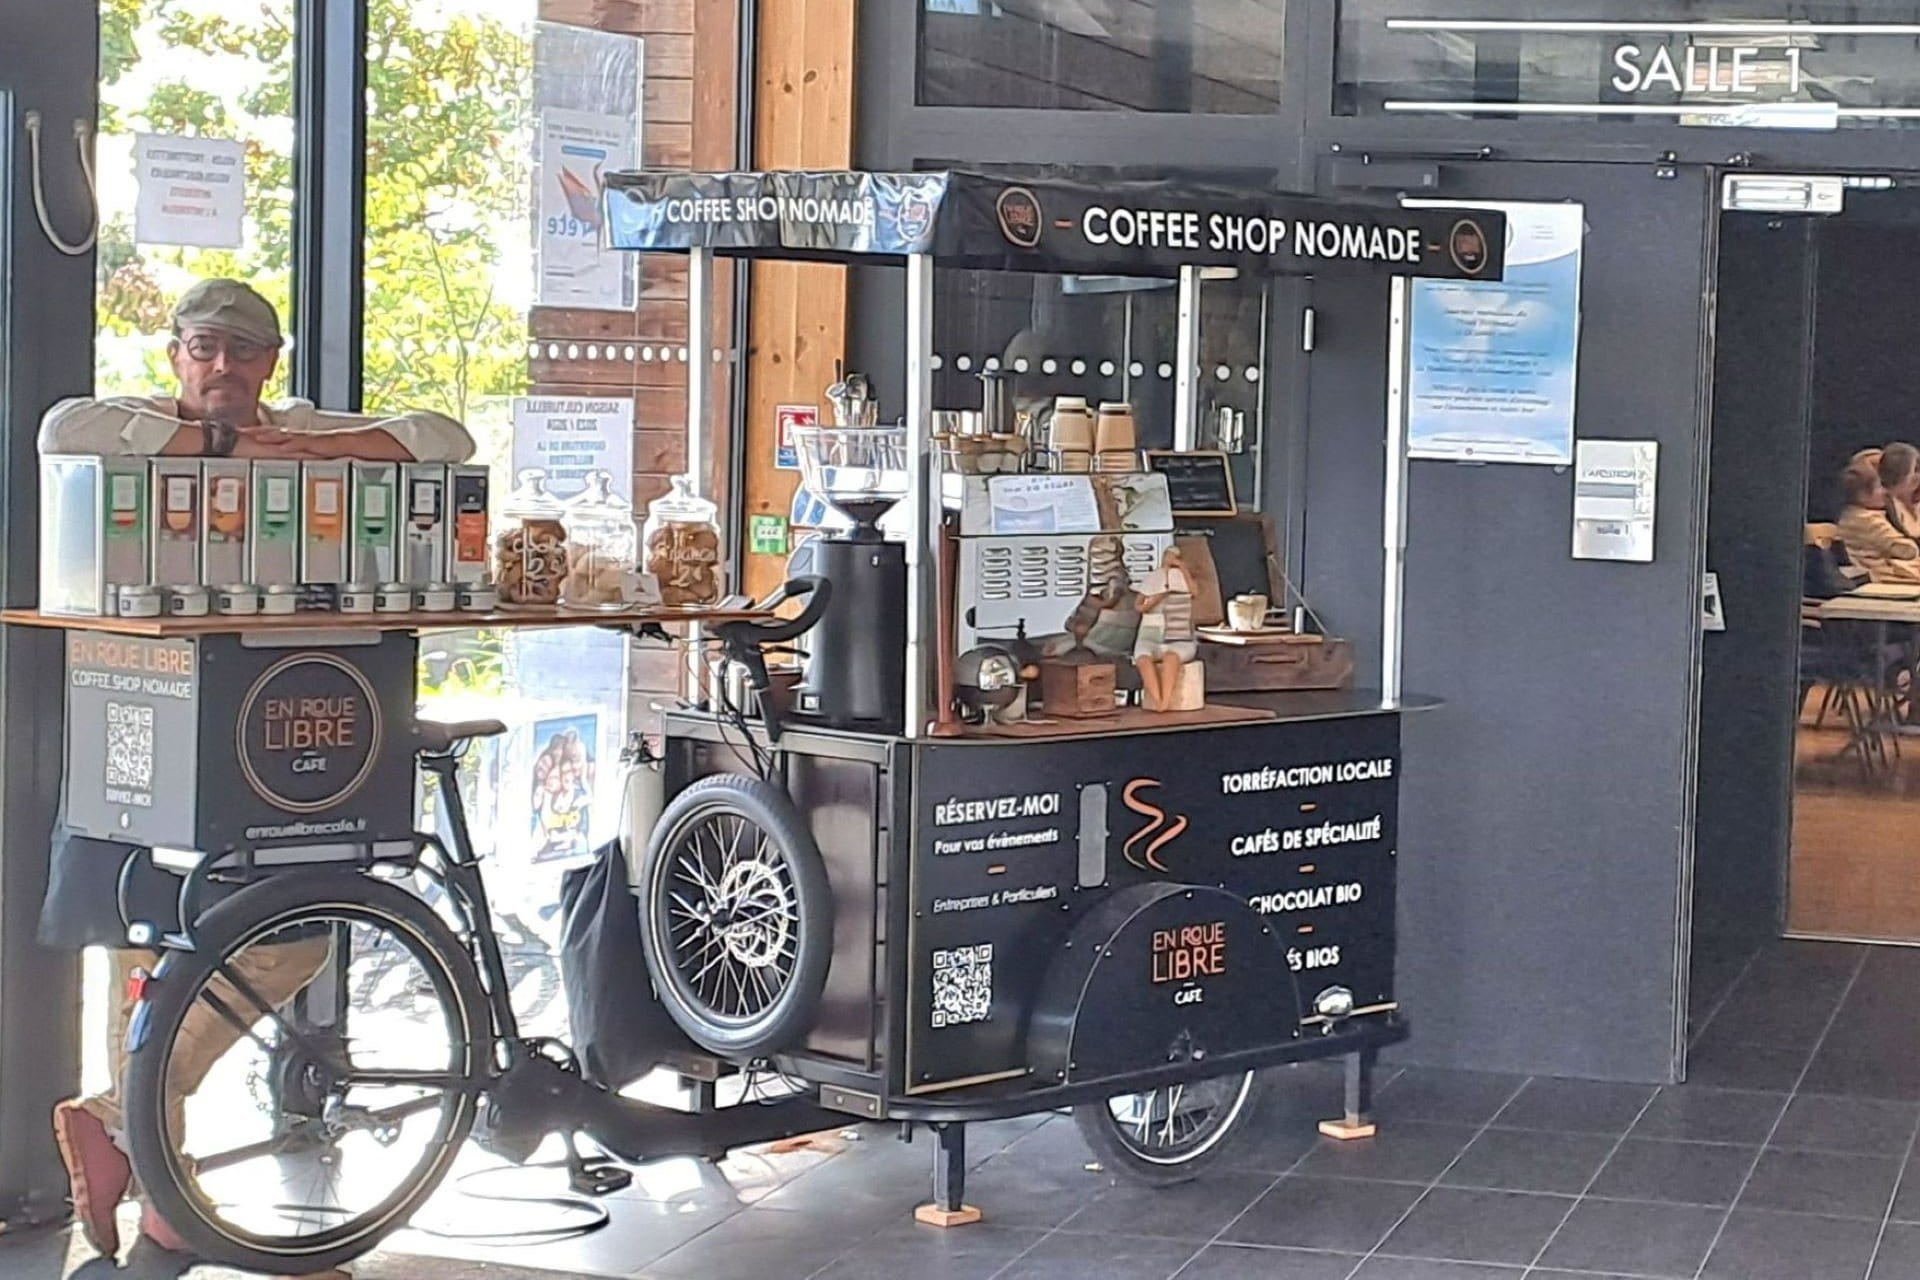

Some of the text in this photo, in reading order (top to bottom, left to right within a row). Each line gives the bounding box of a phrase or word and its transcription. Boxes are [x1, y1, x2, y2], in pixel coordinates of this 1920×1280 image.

[1612, 45, 1800, 92] SALLE 1
[667, 199, 731, 222] COFFEE
[790, 199, 875, 223] NOMADE
[1083, 207, 1199, 248] COFFEE
[1209, 214, 1286, 254] SHOP
[1295, 221, 1420, 261] NOMADE
[72, 639, 192, 676] EN ROUE LIBRE
[72, 669, 191, 699] COFFEE SHOP NOMADE
[265, 697, 354, 720] EN ROUE
[265, 718, 355, 750] LIBRE
[1222, 758, 1393, 794] TORRÉFACTION LOCALE
[935, 793, 1060, 826] RÉSERVEZ-MOI
[934, 840, 962, 855] Pour
[963, 839, 985, 852] vos
[1231, 814, 1381, 856] CAFÉS DE SPÉCIALITÉ
[1001, 886, 1057, 904] Particuliers
[1335, 882, 1361, 904] BIO
[1153, 922, 1226, 952] EN ROUE
[1153, 943, 1226, 982] LIBRE
[1306, 945, 1340, 969] BIOS
